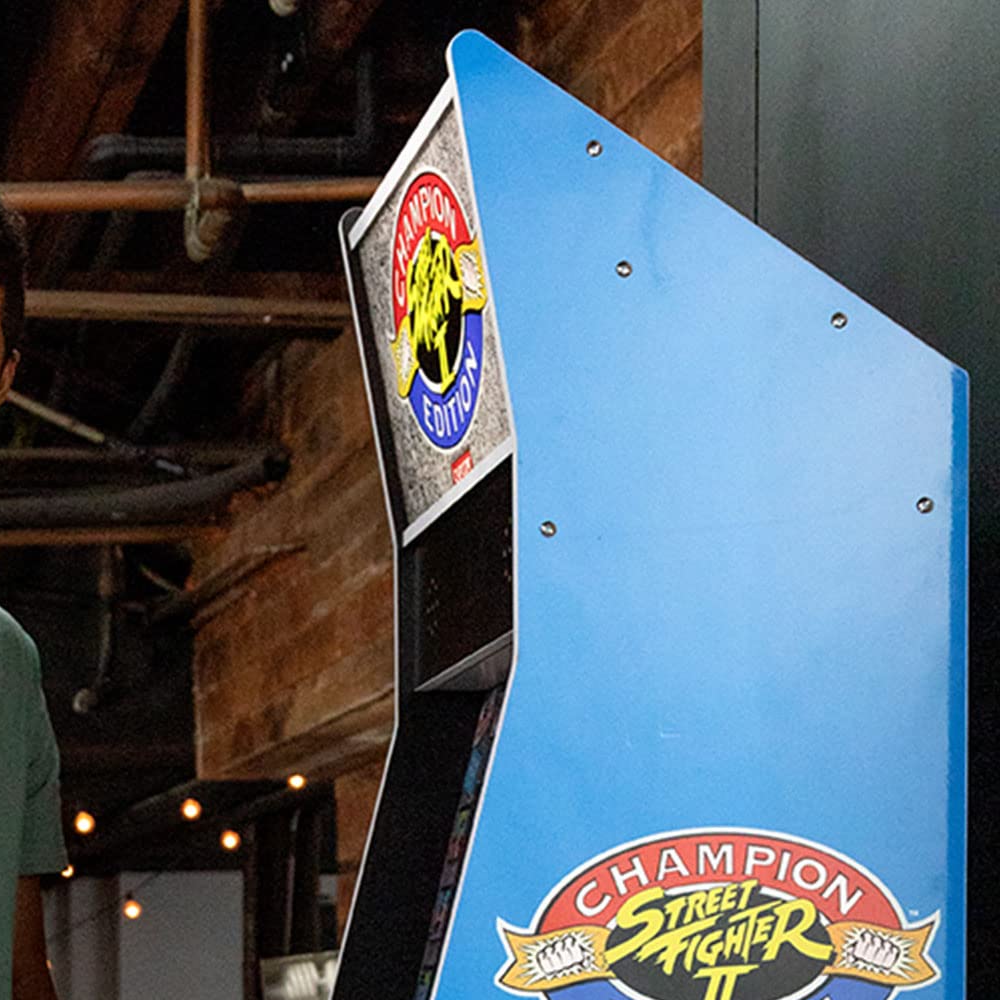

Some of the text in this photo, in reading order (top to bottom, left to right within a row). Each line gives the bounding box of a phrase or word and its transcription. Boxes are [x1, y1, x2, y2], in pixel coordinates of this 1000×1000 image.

[395, 185, 457, 307] CHAMPION
[422, 340, 478, 438] EDITION
[576, 843, 864, 917] CHAMPION
[603, 879, 759, 965] STREET
[633, 899, 834, 976] FIGHTER
